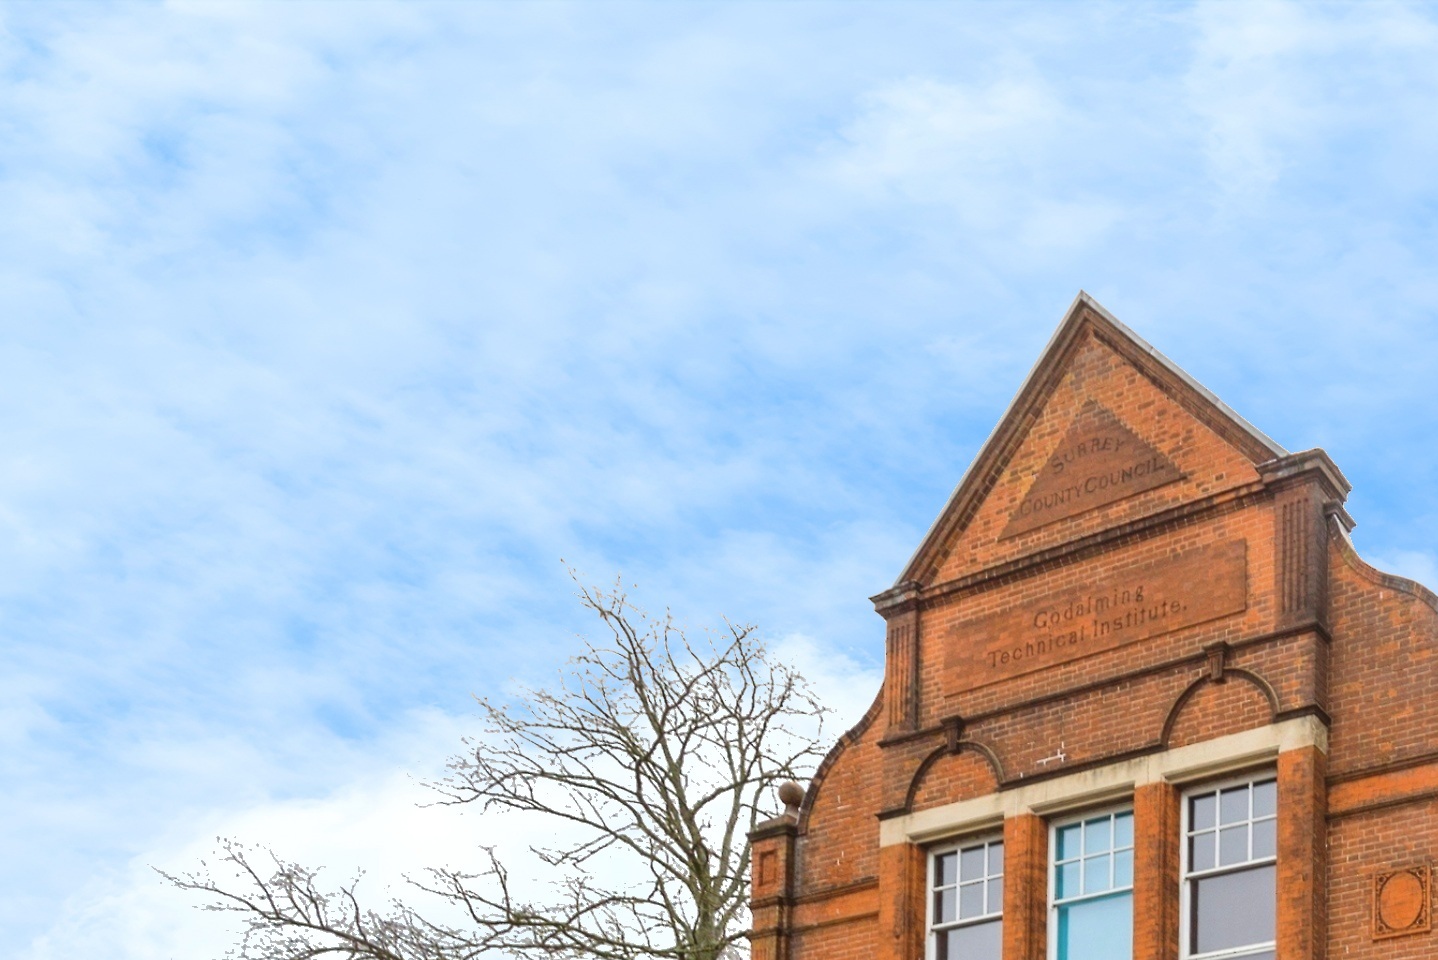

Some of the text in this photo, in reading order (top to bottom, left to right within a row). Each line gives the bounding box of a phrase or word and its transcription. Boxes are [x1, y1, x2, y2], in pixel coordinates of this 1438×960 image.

[1051, 437, 1125, 475] SURREY
[1020, 457, 1164, 516] COUNTY COUNCIL
[1033, 585, 1144, 629] Godalming
[988, 599, 1188, 668] Technical Institute.
